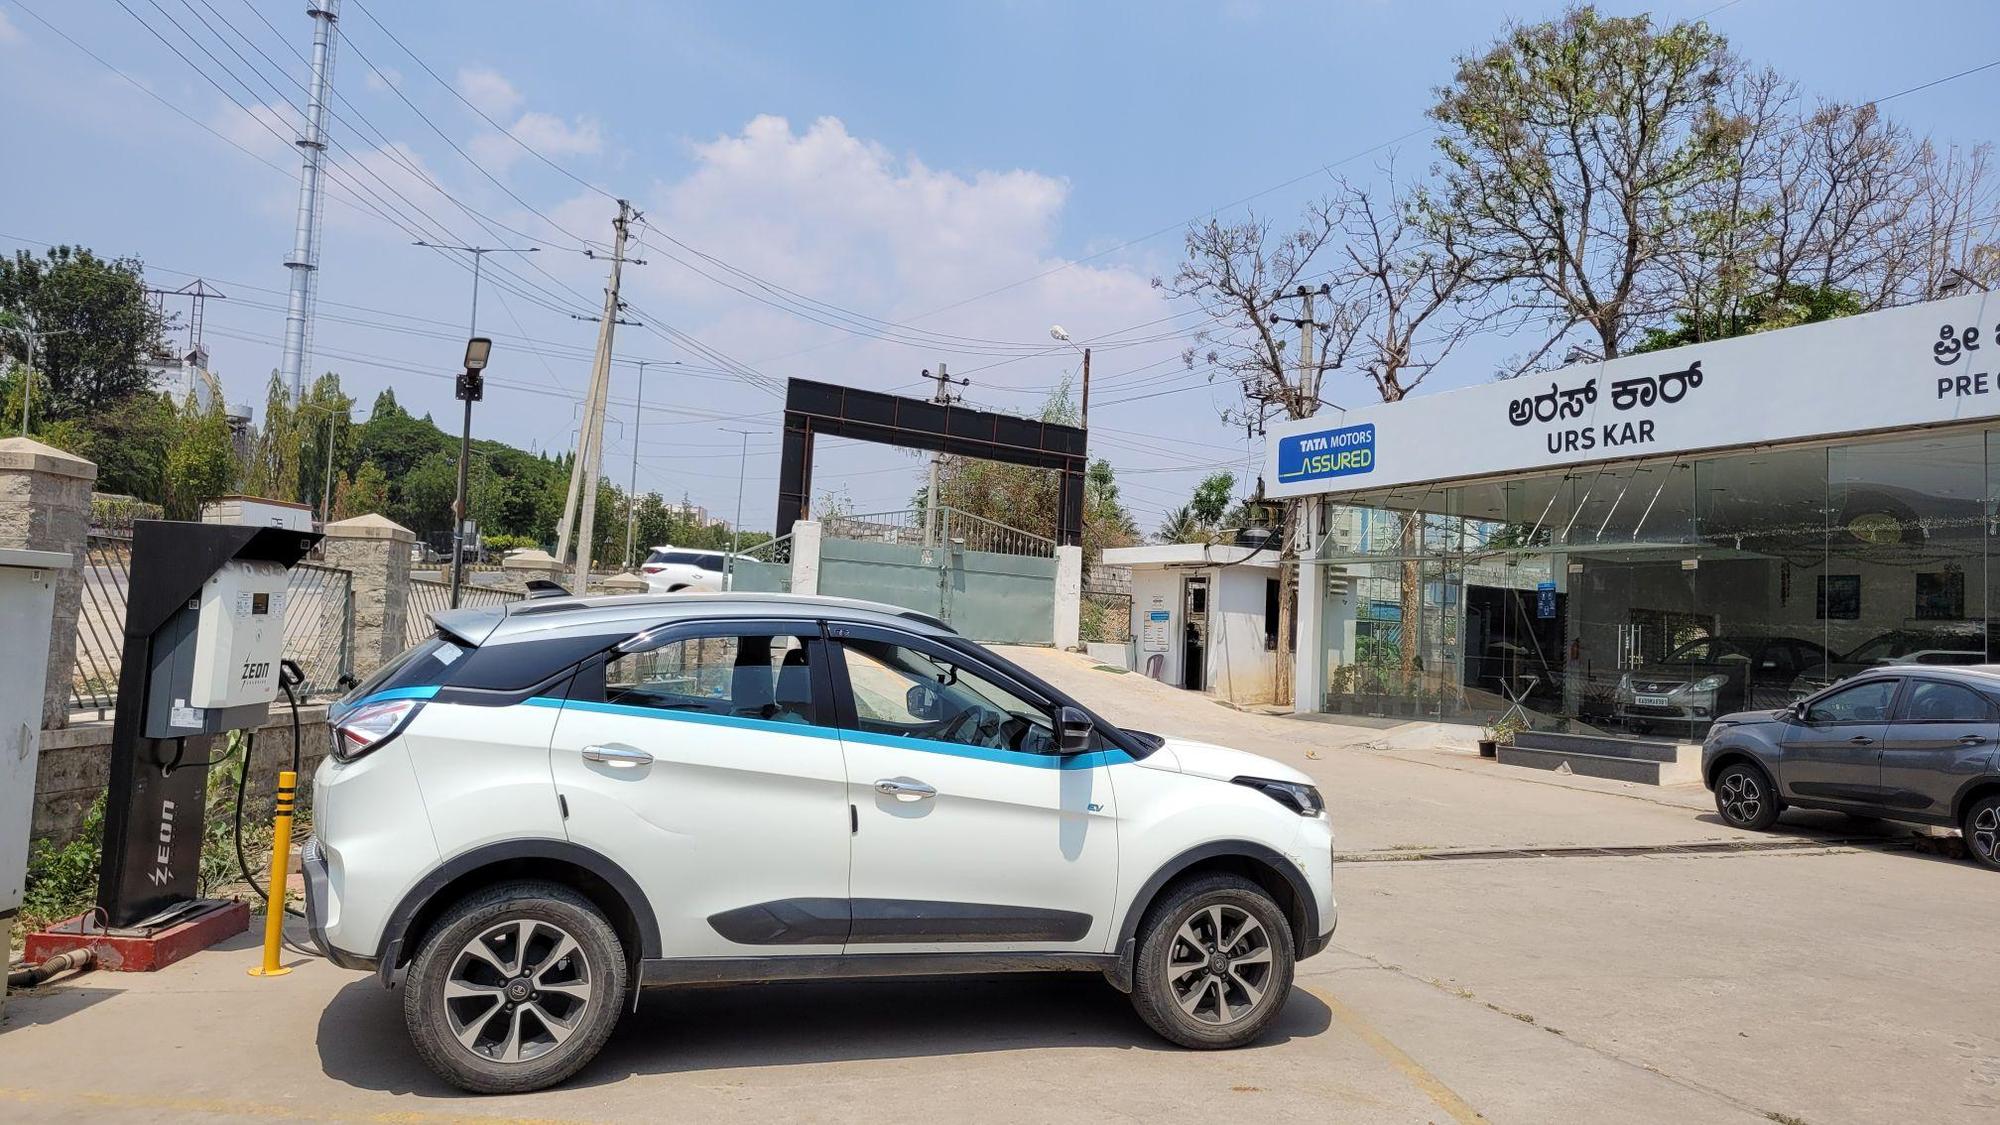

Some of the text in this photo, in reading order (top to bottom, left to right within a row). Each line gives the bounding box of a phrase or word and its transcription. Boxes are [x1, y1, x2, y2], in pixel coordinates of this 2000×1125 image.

[1933, 324, 1980, 366] ಪ್ರೀ
[1509, 360, 1704, 427] ಅರಸ್ ಕಾರ್
[1937, 372, 1989, 399] PRE
[1300, 430, 1372, 453] TATA MOTORS
[1548, 419, 1655, 454] URS KAR
[1301, 448, 1372, 475] ASSURED
[241, 660, 270, 681] ZEON
[1087, 803, 1104, 812] EV
[153, 799, 175, 887] ZEON
